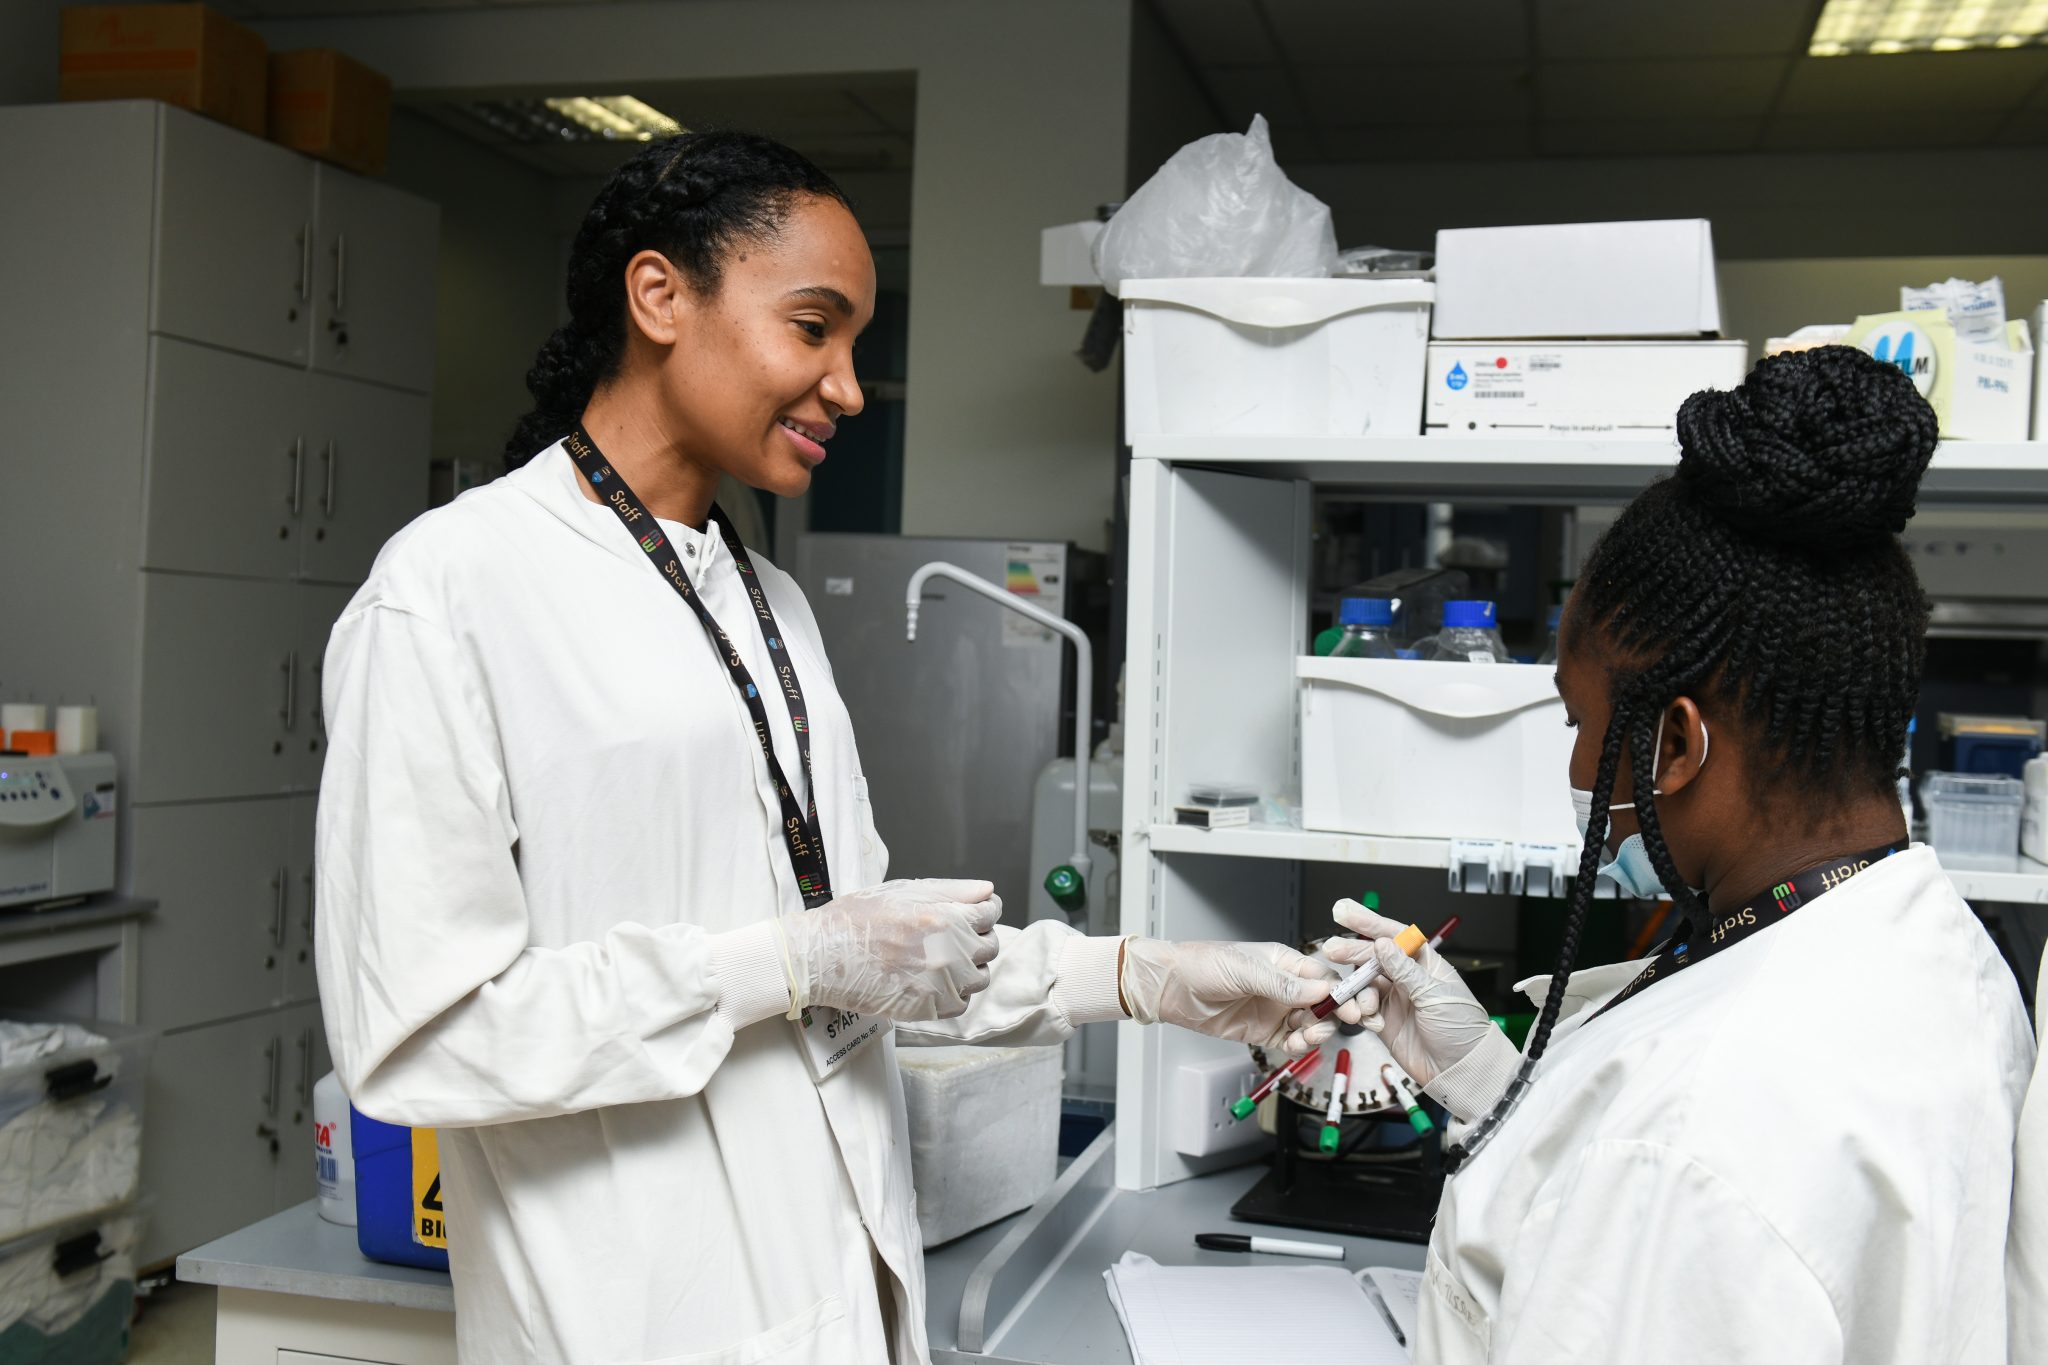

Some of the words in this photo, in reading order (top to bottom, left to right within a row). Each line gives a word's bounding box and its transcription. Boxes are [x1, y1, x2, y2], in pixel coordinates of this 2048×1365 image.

[567, 431, 591, 460] Staff
[610, 490, 642, 522] Staff
[750, 587, 772, 622] Staff
[778, 665, 800, 701] Staff
[787, 817, 810, 857] Staff
[1710, 907, 1757, 944] Staff
[826, 1010, 860, 1040] STAF
[826, 1047, 847, 1067] ACCESS
[846, 1036, 861, 1052] CARD
